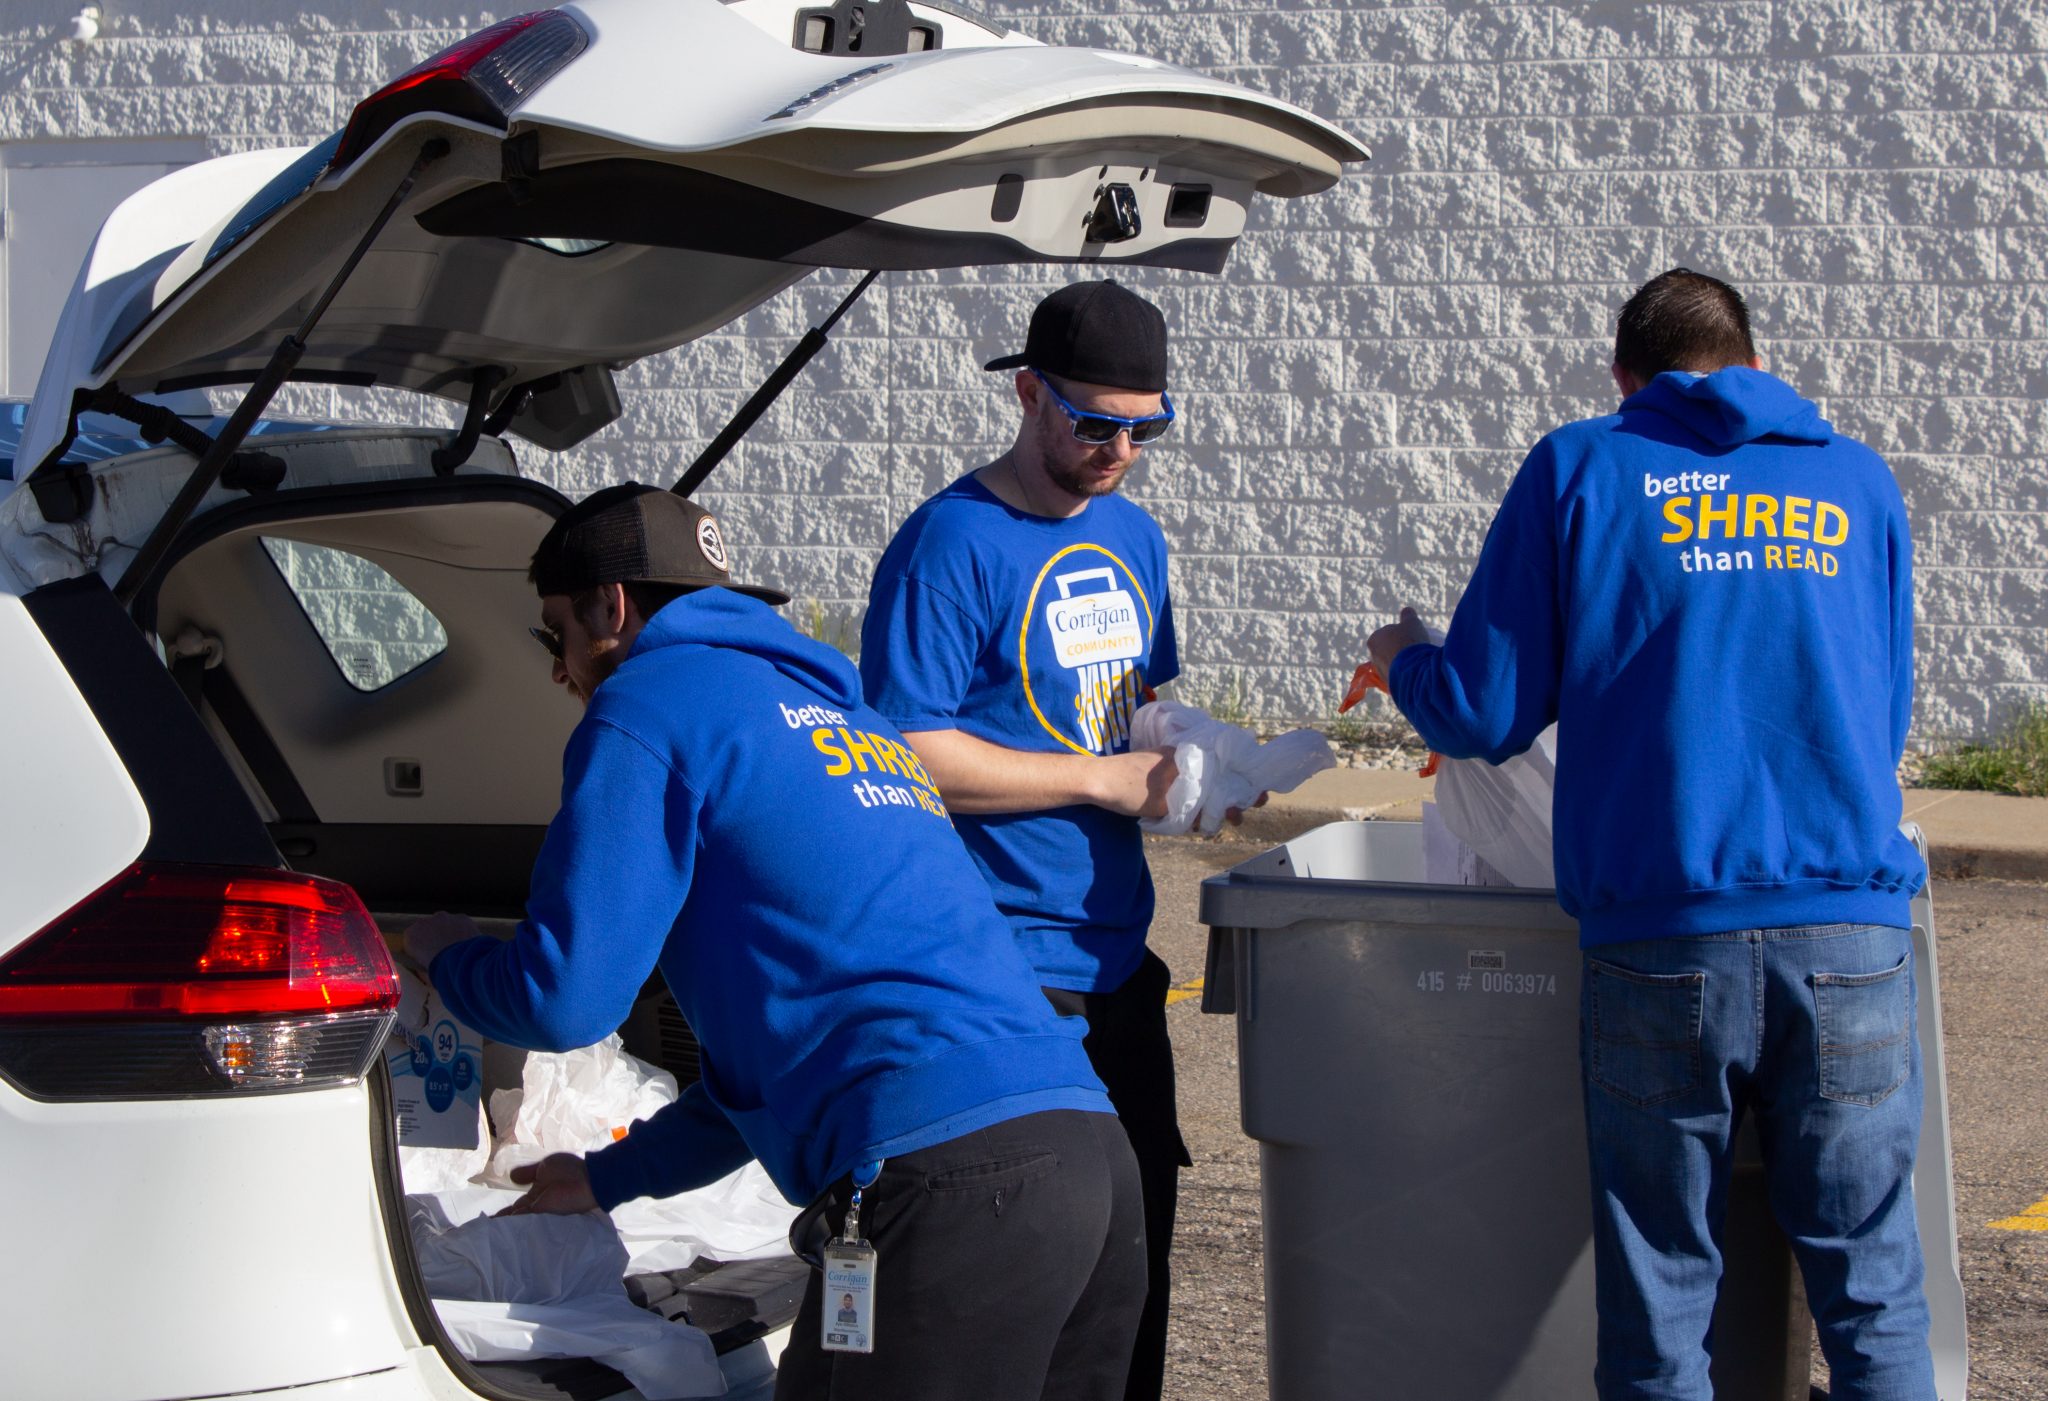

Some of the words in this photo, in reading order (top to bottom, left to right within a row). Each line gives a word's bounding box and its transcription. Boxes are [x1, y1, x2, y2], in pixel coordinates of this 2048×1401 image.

[1644, 471, 1730, 497] better
[1661, 494, 1848, 546] SHRED
[1679, 546, 1753, 573] than
[1765, 545, 1838, 576] READ
[1055, 604, 1130, 635] Corrigan
[1066, 635, 1136, 656] COMMUNITY
[779, 703, 848, 729] better
[853, 779, 915, 808] than
[1417, 971, 1444, 991] 415
[1456, 972, 1472, 991] #
[1482, 972, 1556, 995] 0063974
[438, 1033, 453, 1051] 94
